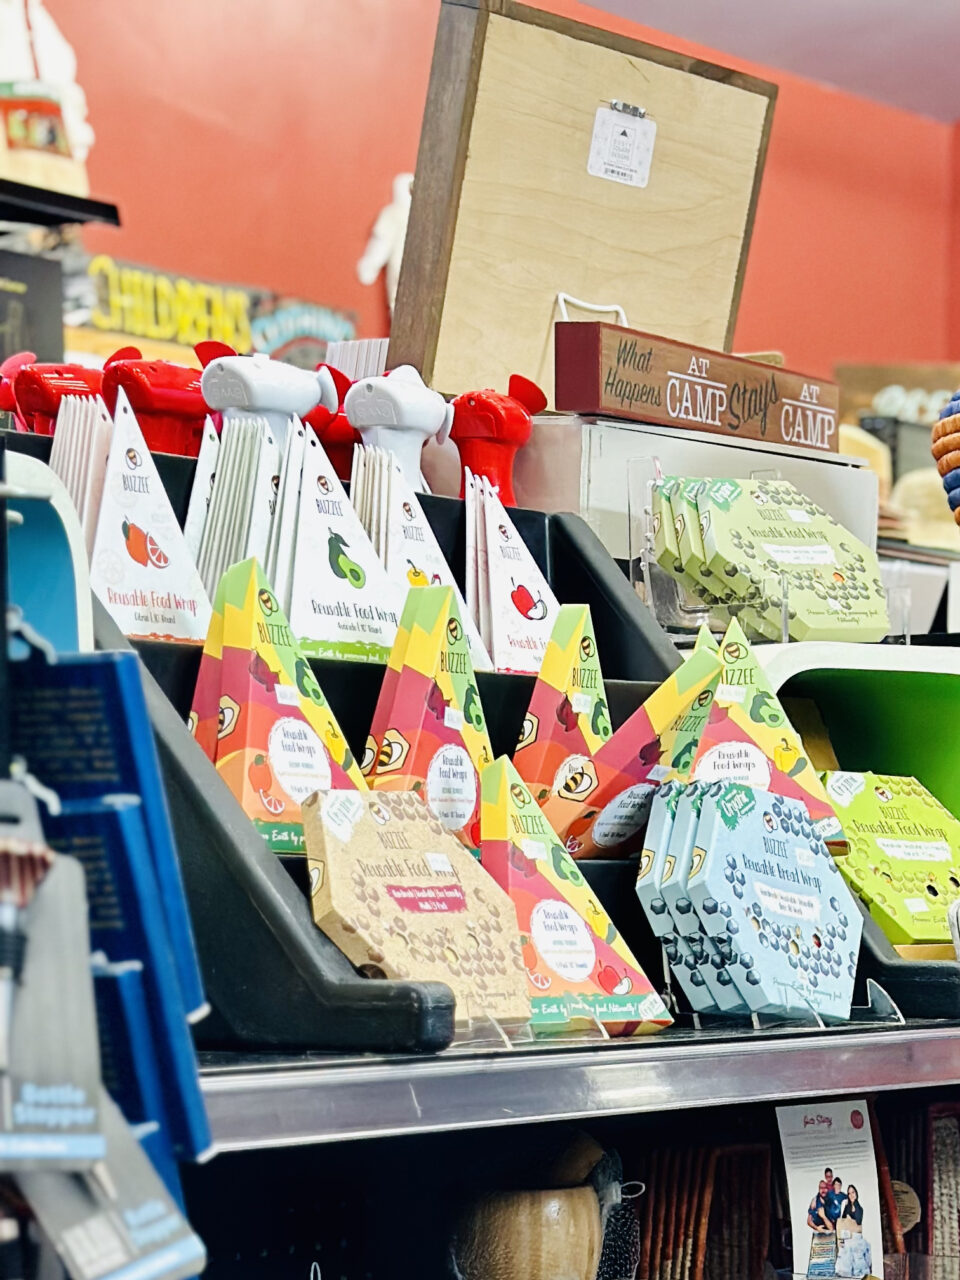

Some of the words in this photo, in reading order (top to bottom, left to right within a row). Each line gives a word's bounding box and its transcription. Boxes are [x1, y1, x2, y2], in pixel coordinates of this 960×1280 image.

[616, 338, 654, 375] What
[687, 355, 710, 378] AT
[604, 367, 662, 408] Happens
[800, 383, 820, 404] AT
[666, 378, 727, 427] CAMP
[727, 373, 779, 437] Stays
[781, 404, 836, 449] CAMP
[121, 473, 150, 494] BUZZEE
[315, 498, 344, 518] BUZZEE
[402, 524, 425, 542] BUZZEE
[783, 527, 806, 539] Food
[500, 545, 522, 561] BUZZEE
[106, 586, 149, 609] Reusable
[150, 590, 172, 610] Food
[173, 593, 199, 617] Wrap
[311, 599, 351, 617] Reusable
[353, 602, 374, 621] Food
[375, 606, 398, 627] Wrap
[257, 621, 293, 648] BUZZEE
[440, 650, 468, 675] BUZZEE
[572, 667, 598, 690] BUZZEE
[671, 715, 705, 732] BUZZEE
[281, 740, 297, 752] Food
[718, 749, 750, 761] Reusable
[442, 754, 464, 767] Reusable
[713, 760, 731, 770] Food
[731, 760, 757, 773] Wraps
[439, 767, 451, 779] Food
[452, 768, 468, 783] Wraps
[879, 806, 910, 821] BUZZEE
[511, 814, 547, 836] BUZZEE
[852, 819, 896, 836] Reusable
[898, 821, 919, 837] Food
[919, 823, 949, 843] Wrap
[271, 829, 290, 842] Earth
[290, 830, 300, 846] by
[377, 831, 413, 850] BUZZEE
[763, 836, 789, 859] BUZZEE
[357, 858, 408, 879] Reusable
[404, 859, 429, 879] Food
[743, 852, 777, 875] Reusable
[776, 862, 800, 884] Bread
[801, 868, 823, 894] Wrap
[543, 920, 559, 933] Food
[541, 1003, 560, 1015] Earth
[560, 1003, 568, 1017] by
